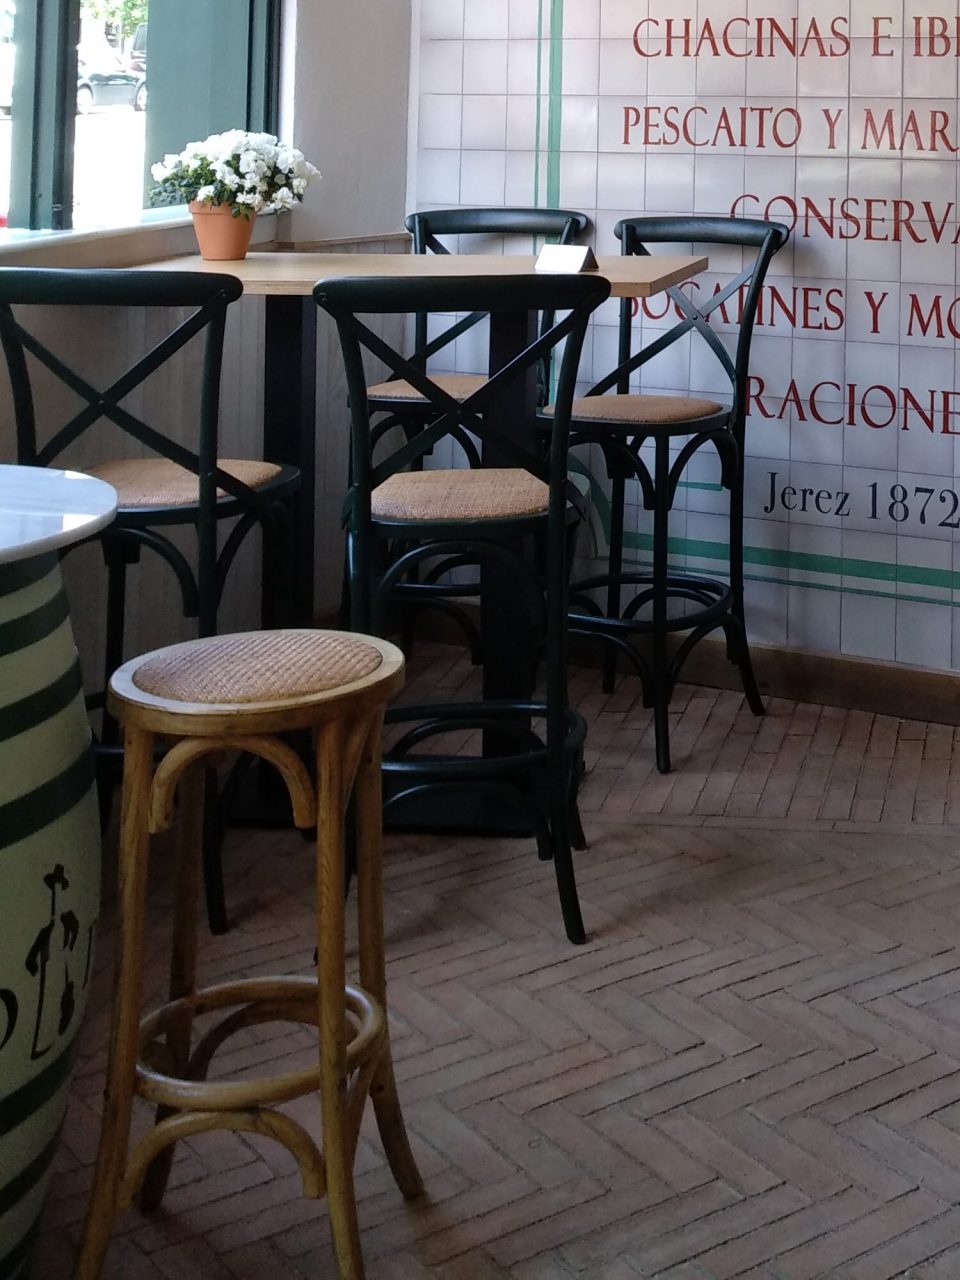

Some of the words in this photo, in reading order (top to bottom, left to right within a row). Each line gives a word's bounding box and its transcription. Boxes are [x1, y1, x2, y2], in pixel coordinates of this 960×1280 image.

[632, 15, 852, 59] CHACINAS
[871, 15, 895, 58] E
[622, 106, 803, 149] PESCAITO
[821, 107, 844, 151] Y
[864, 291, 889, 334] Y
[763, 470, 851, 518] Jerez
